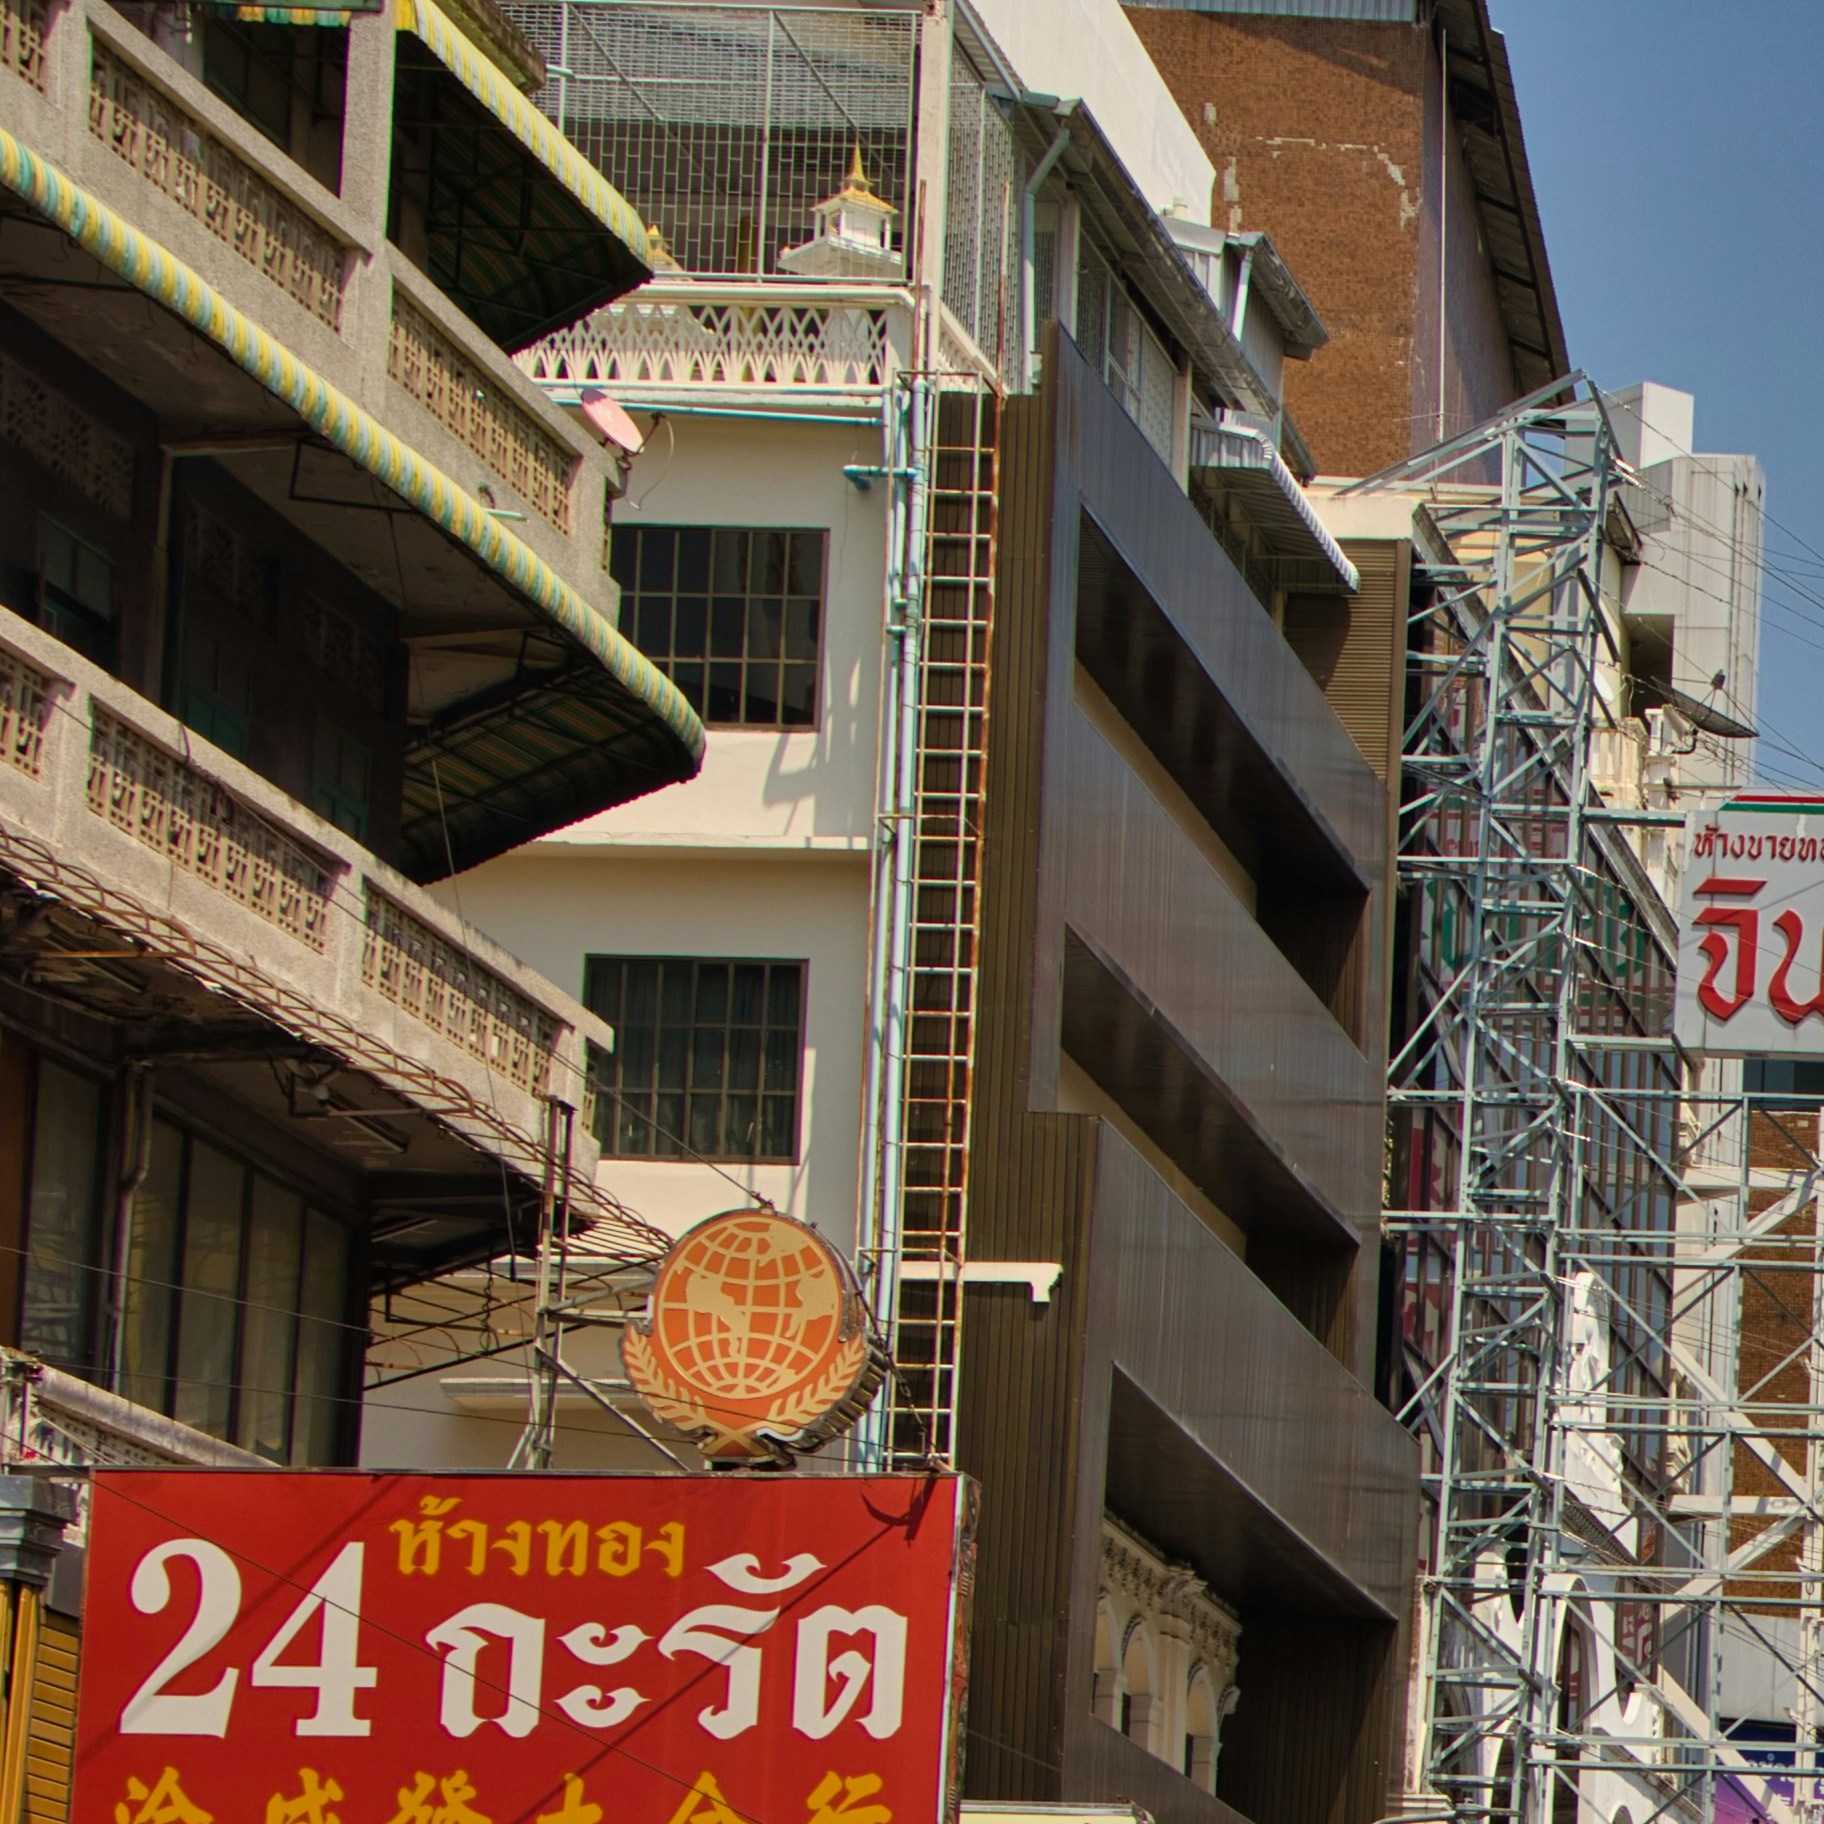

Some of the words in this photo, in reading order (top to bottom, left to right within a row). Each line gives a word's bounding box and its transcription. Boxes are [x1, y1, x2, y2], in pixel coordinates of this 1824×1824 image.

[388, 1493, 688, 1581] ห้างทอง
[119, 1536, 379, 1740] 24
[425, 1550, 911, 1742] กะรัต
